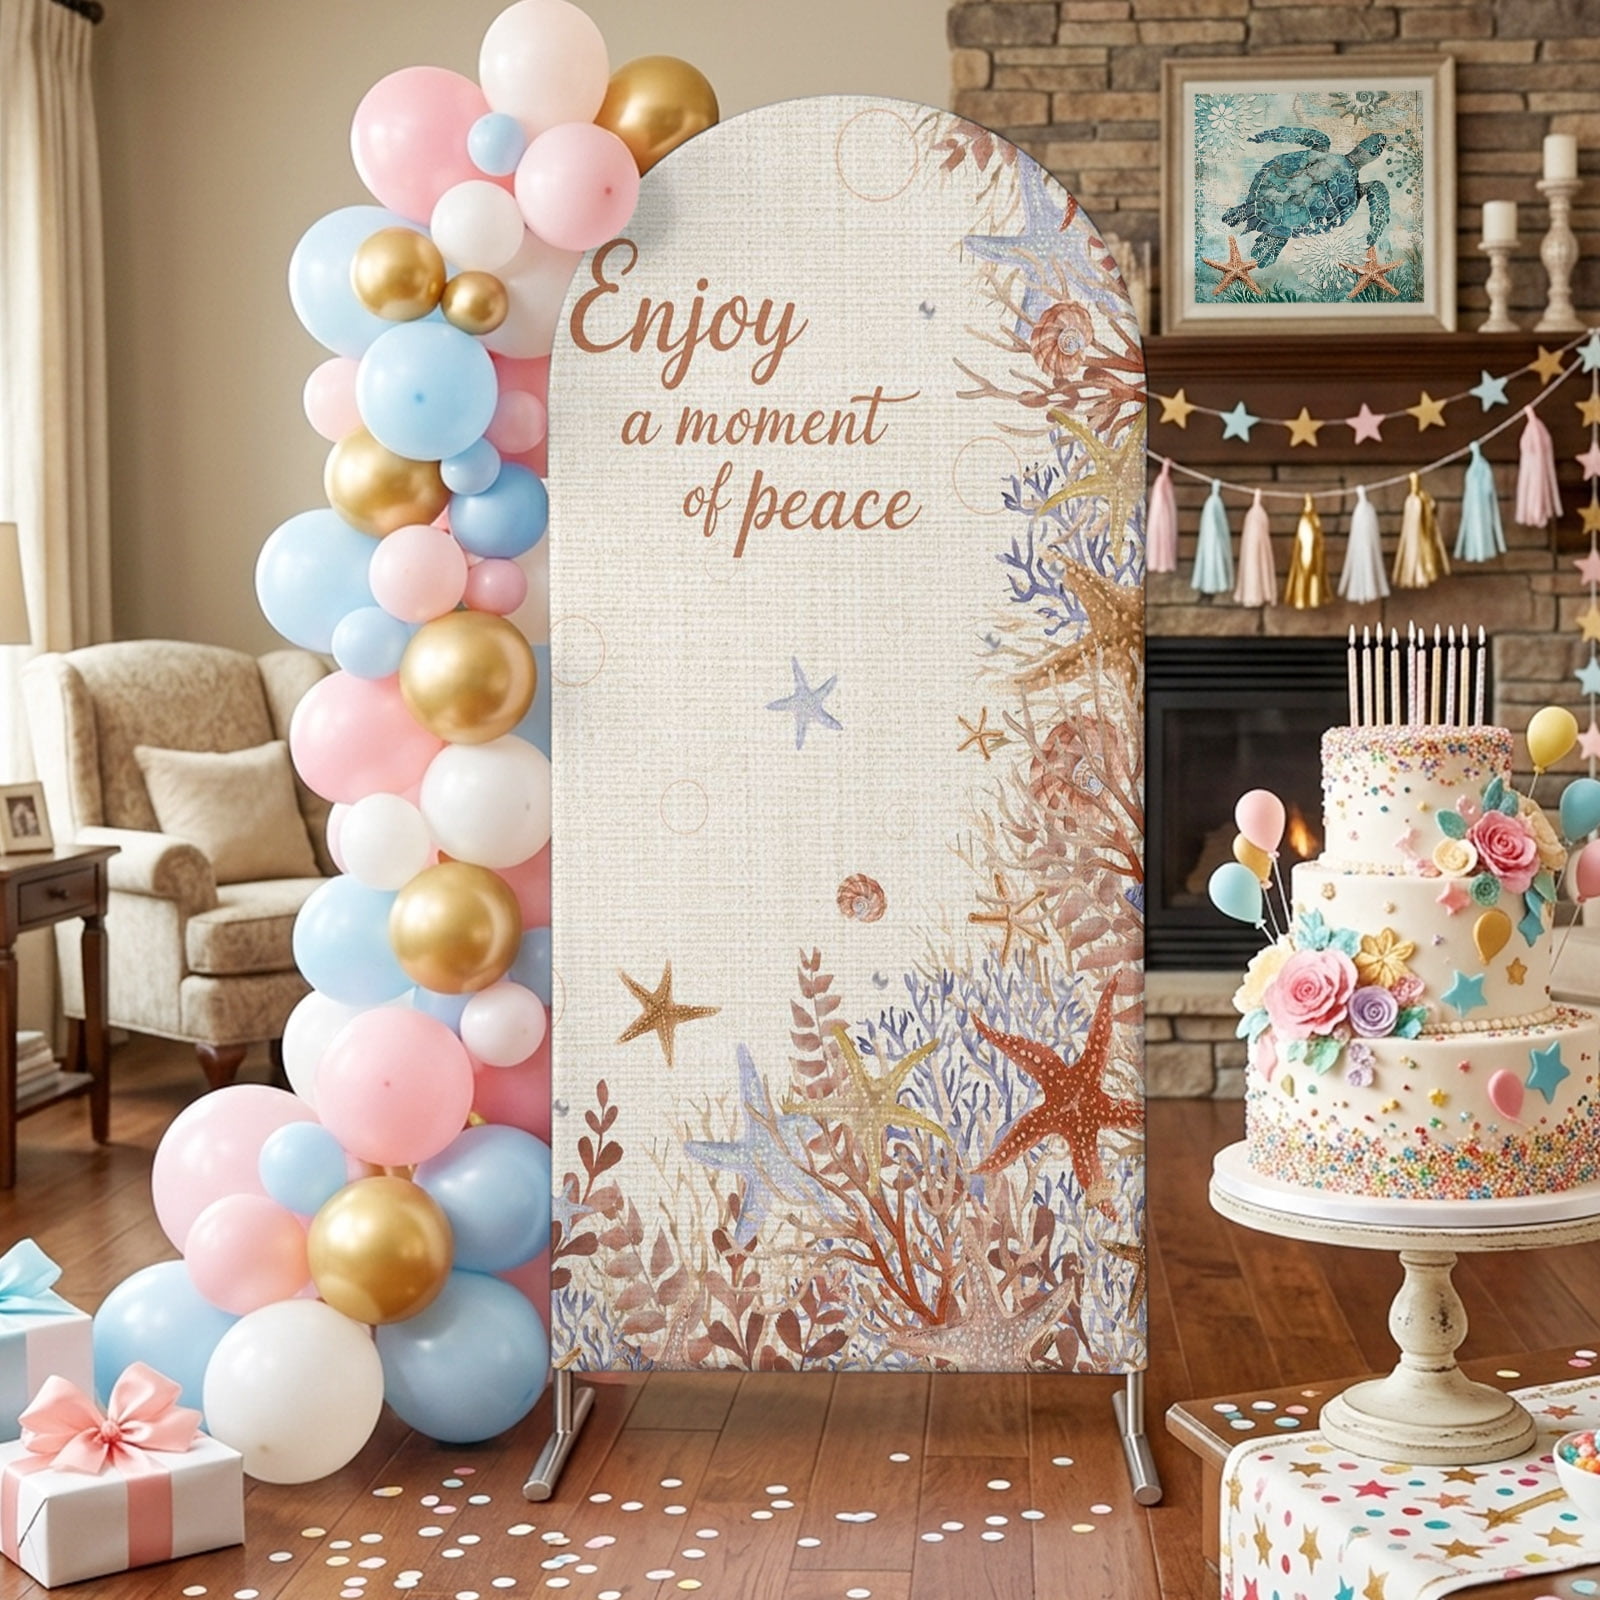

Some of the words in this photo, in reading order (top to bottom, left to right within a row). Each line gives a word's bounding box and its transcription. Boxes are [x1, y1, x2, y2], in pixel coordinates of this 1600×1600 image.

[569, 237, 809, 390] Enjoy
[620, 410, 663, 445] a
[675, 386, 921, 446] moment
[682, 461, 733, 538] of
[732, 469, 923, 558] peace
